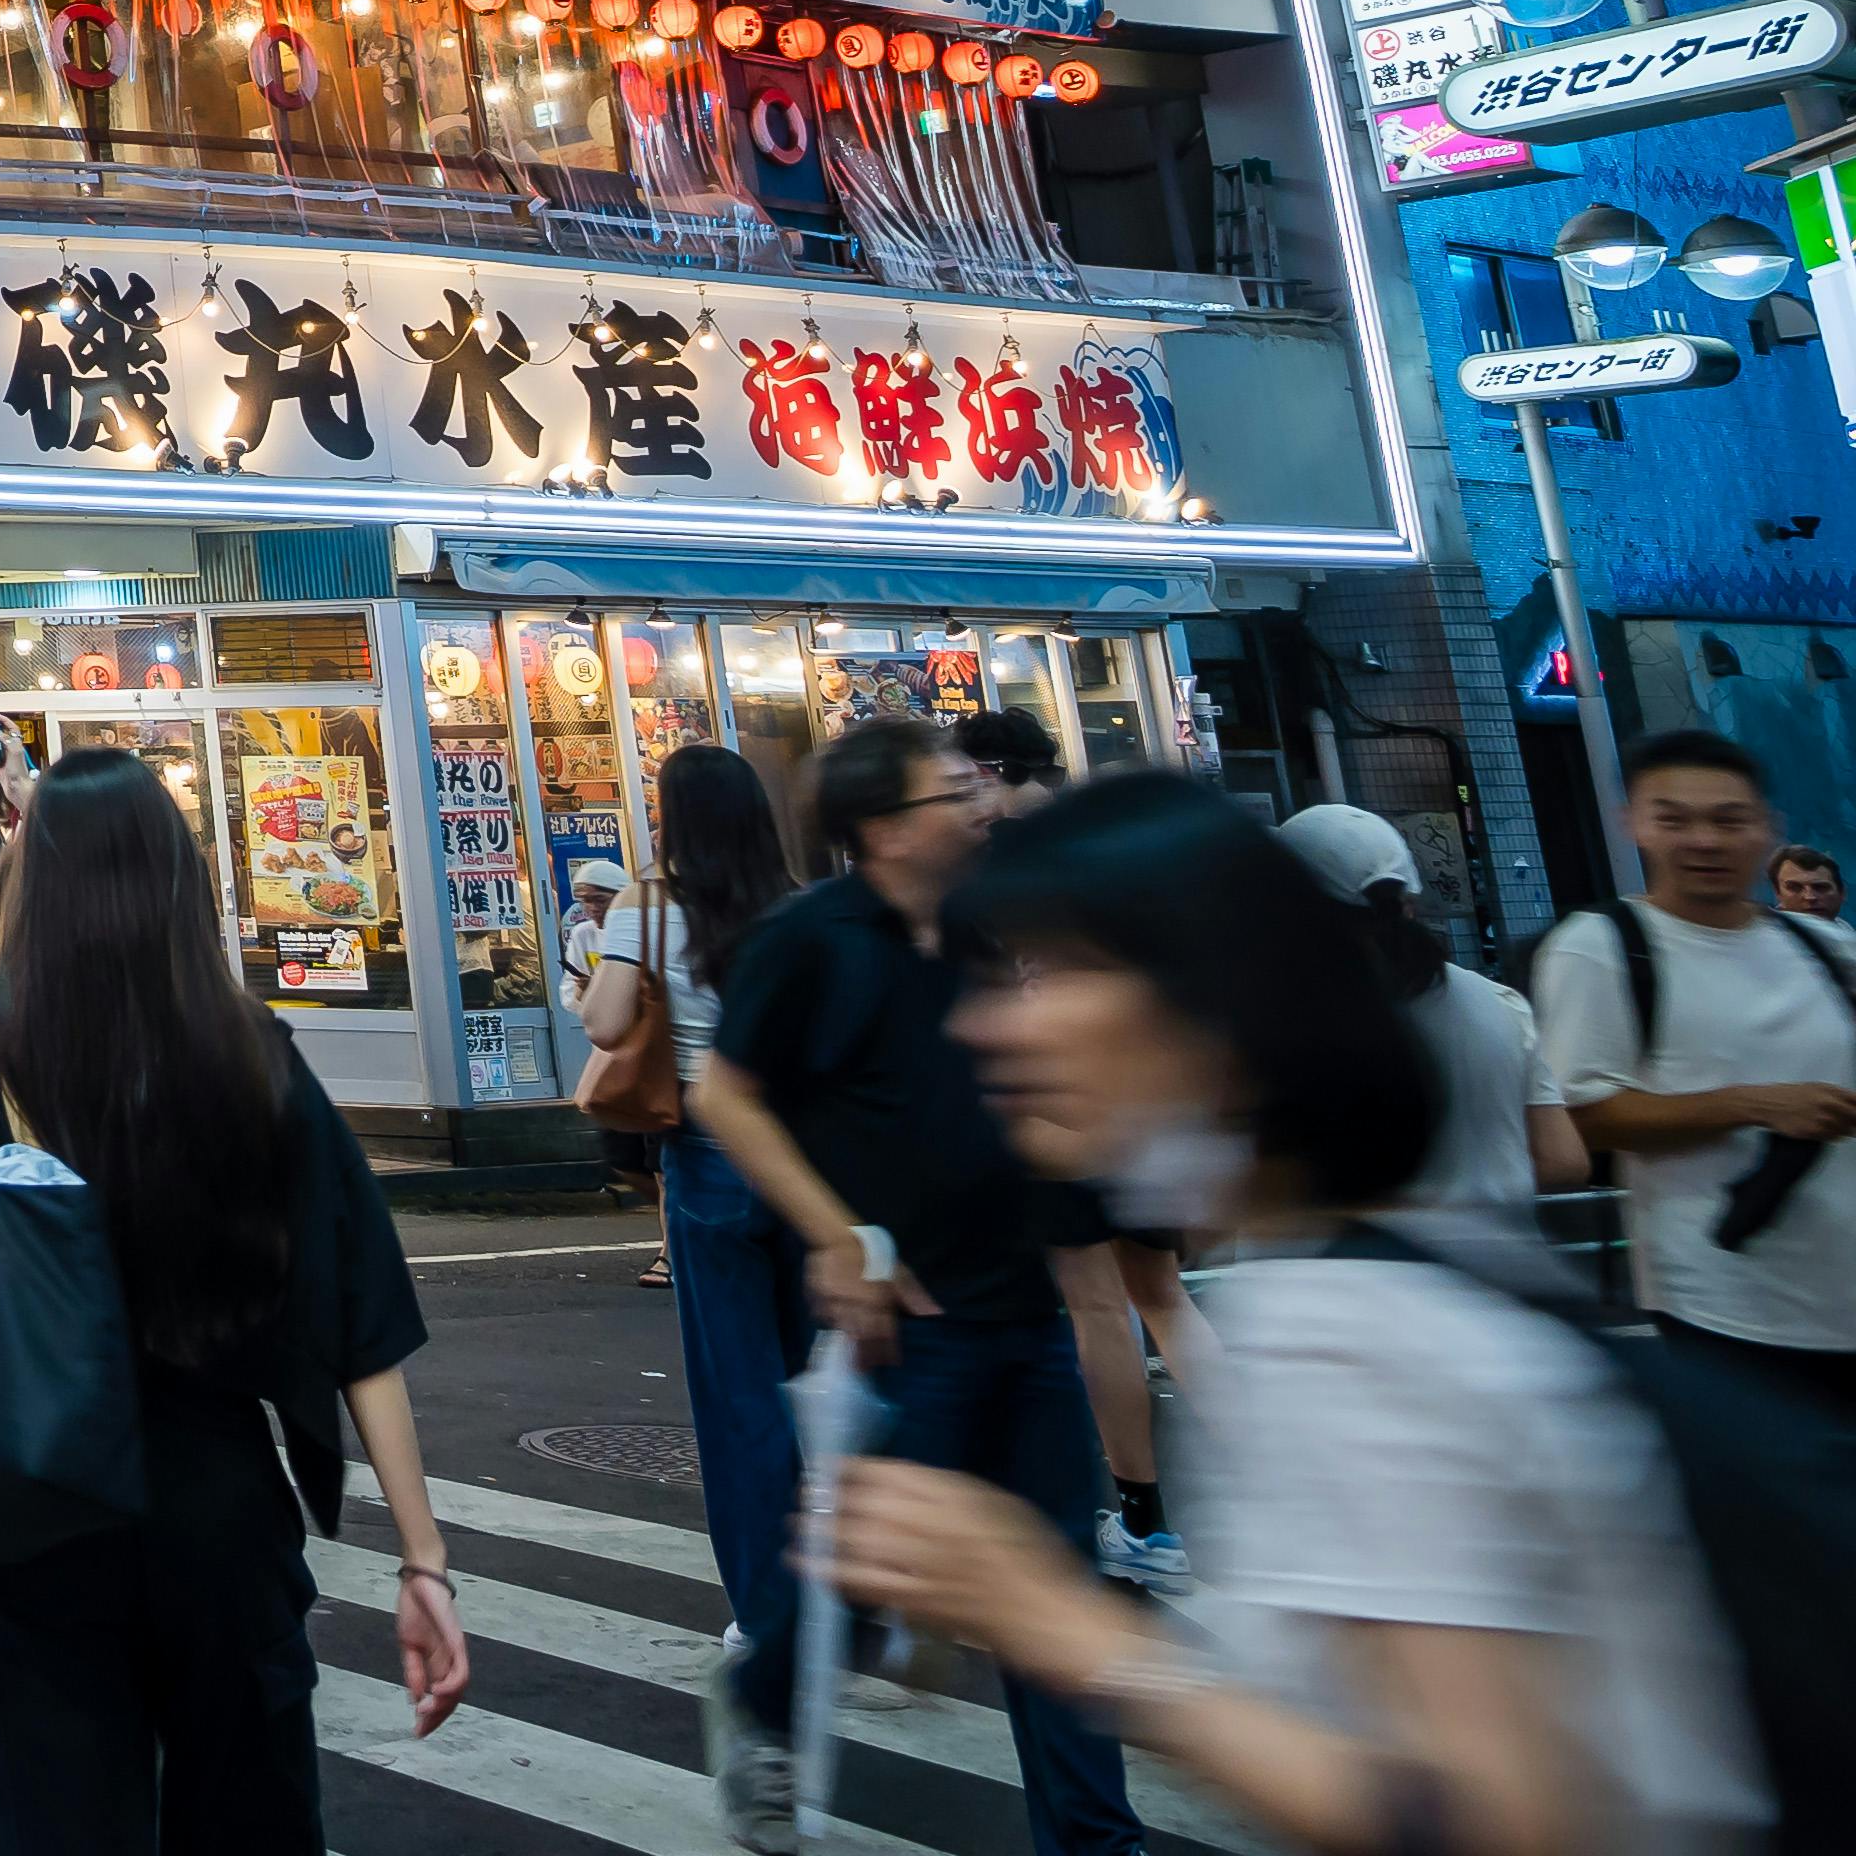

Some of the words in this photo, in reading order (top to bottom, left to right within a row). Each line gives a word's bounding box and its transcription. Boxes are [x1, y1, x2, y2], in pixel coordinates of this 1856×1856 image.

[1407, 25, 1446, 45] 渋谷
[1470, 12, 1810, 116] 渋谷センター街
[0, 266, 713, 481] 磯丸水産
[738, 336, 1156, 492] 海鮮浜焼
[1479, 347, 1676, 389] 渋谷センター街
[549, 813, 618, 835] 社員・アルバイト
[585, 832, 618, 847] 募集中
[486, 850, 514, 866] maru
